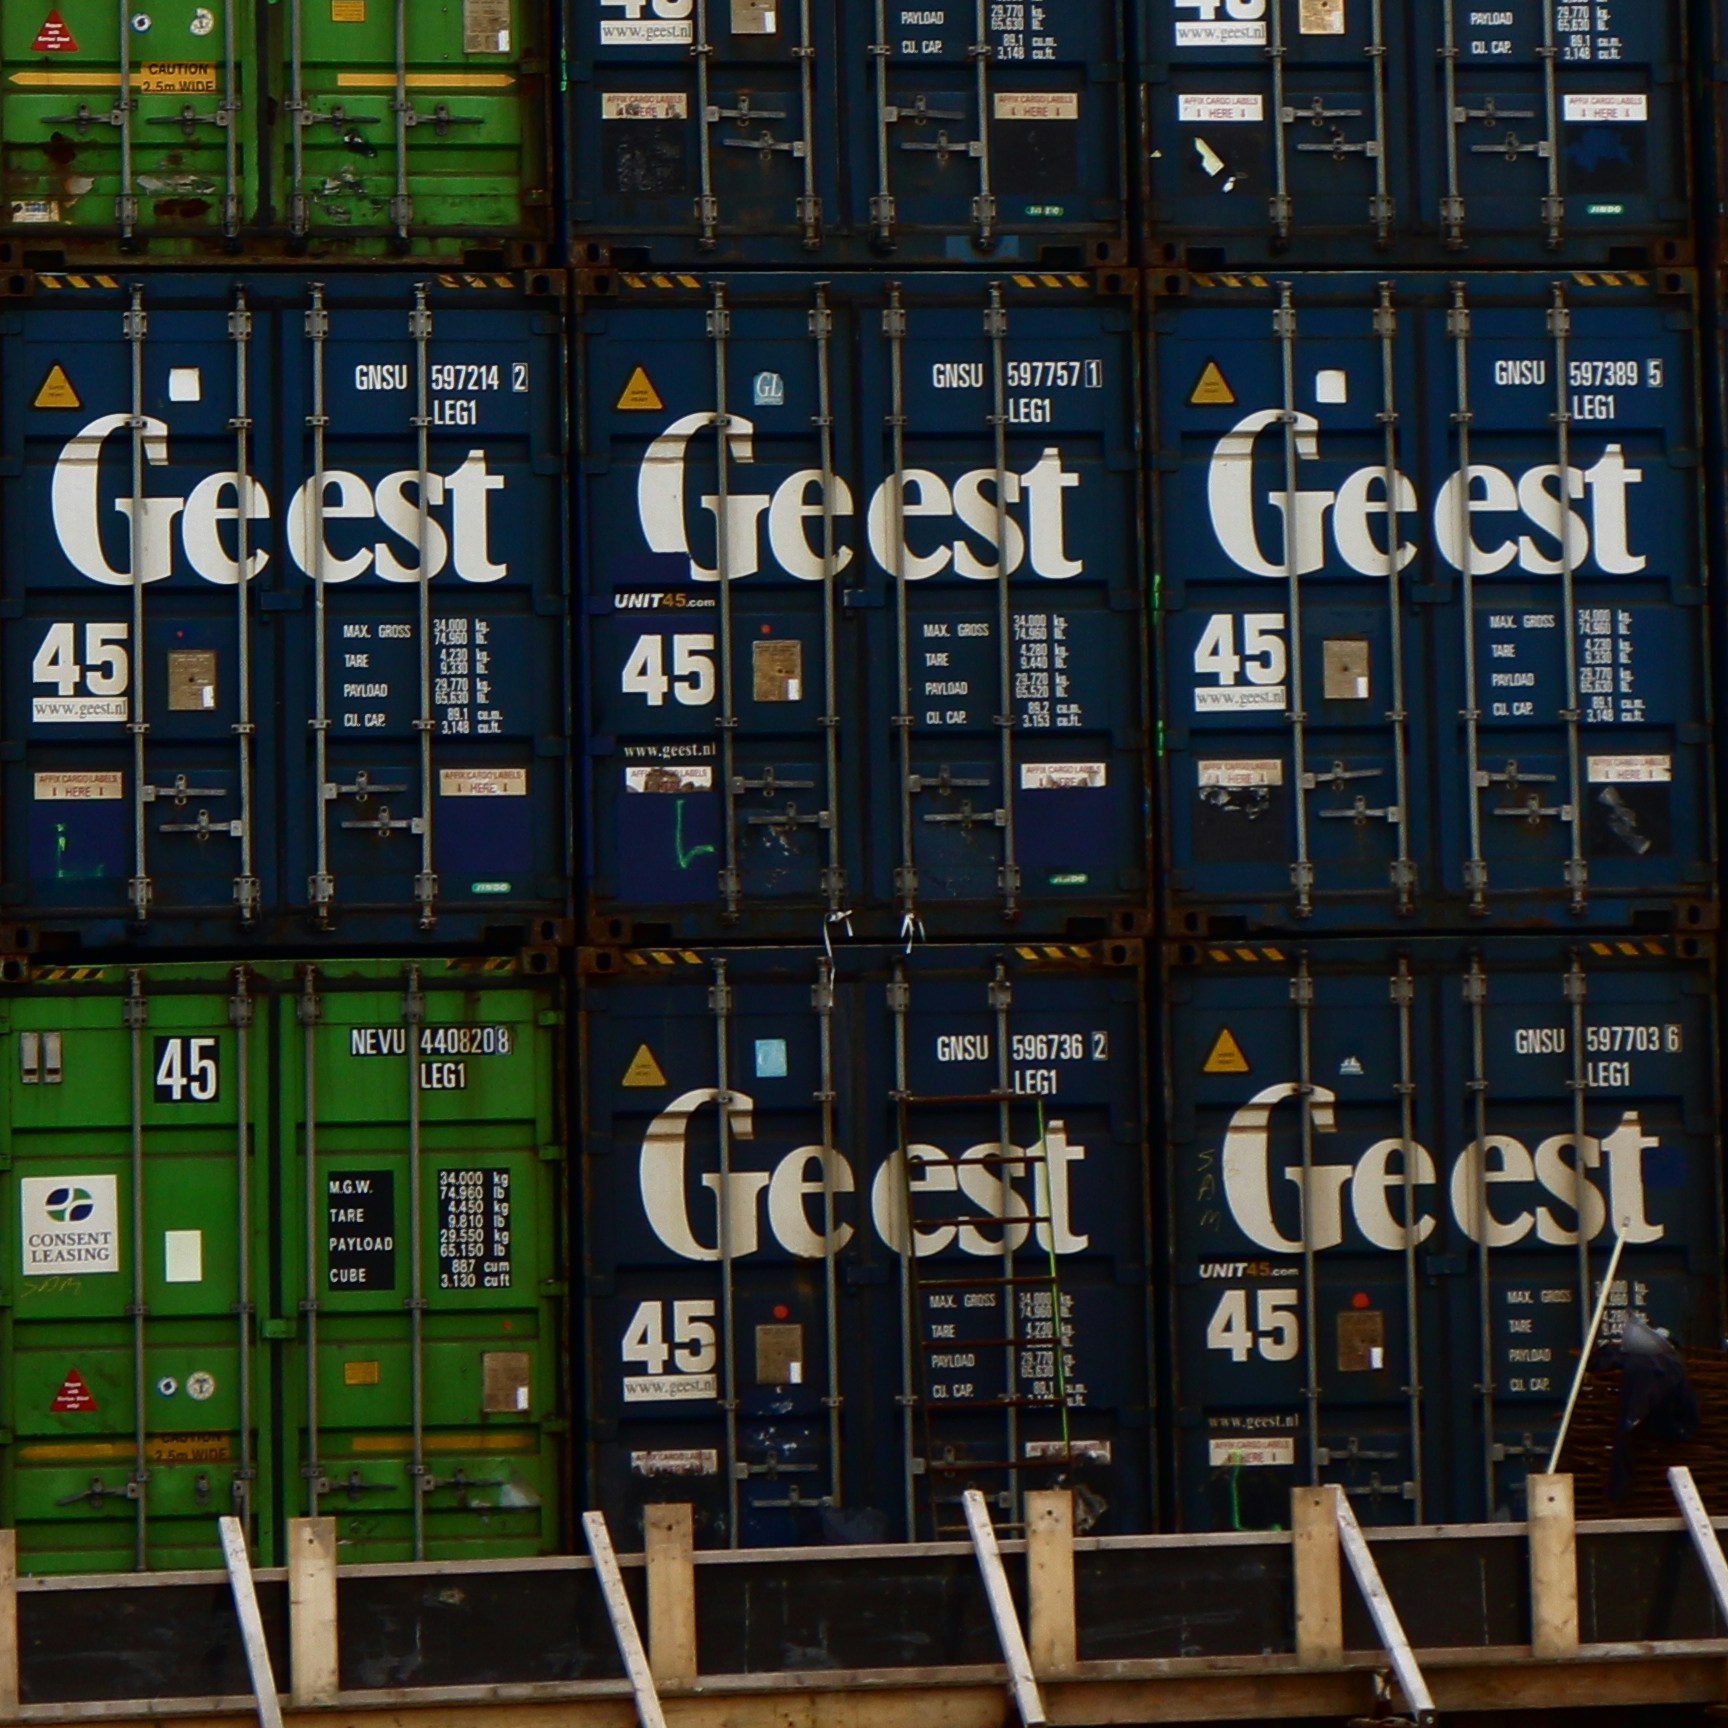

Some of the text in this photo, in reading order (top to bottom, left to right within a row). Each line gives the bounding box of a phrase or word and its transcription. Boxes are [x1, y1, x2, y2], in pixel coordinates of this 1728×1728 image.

[356, 365, 406, 389] GNSU
[432, 365, 498, 389] 597214
[435, 400, 475, 424] LEG1
[51, 414, 507, 585] Geest
[637, 411, 1083, 580] Geest
[1208, 409, 1646, 576] Geest
[33, 623, 127, 695] 45
[623, 635, 713, 705] 45
[157, 1039, 215, 1099] 45
[640, 1088, 1088, 1261] Geest
[1222, 1082, 1664, 1253] Geest
[29, 1234, 110, 1249] CONSENT
[31, 1248, 110, 1264] LEASING
[623, 1301, 713, 1374] 45
